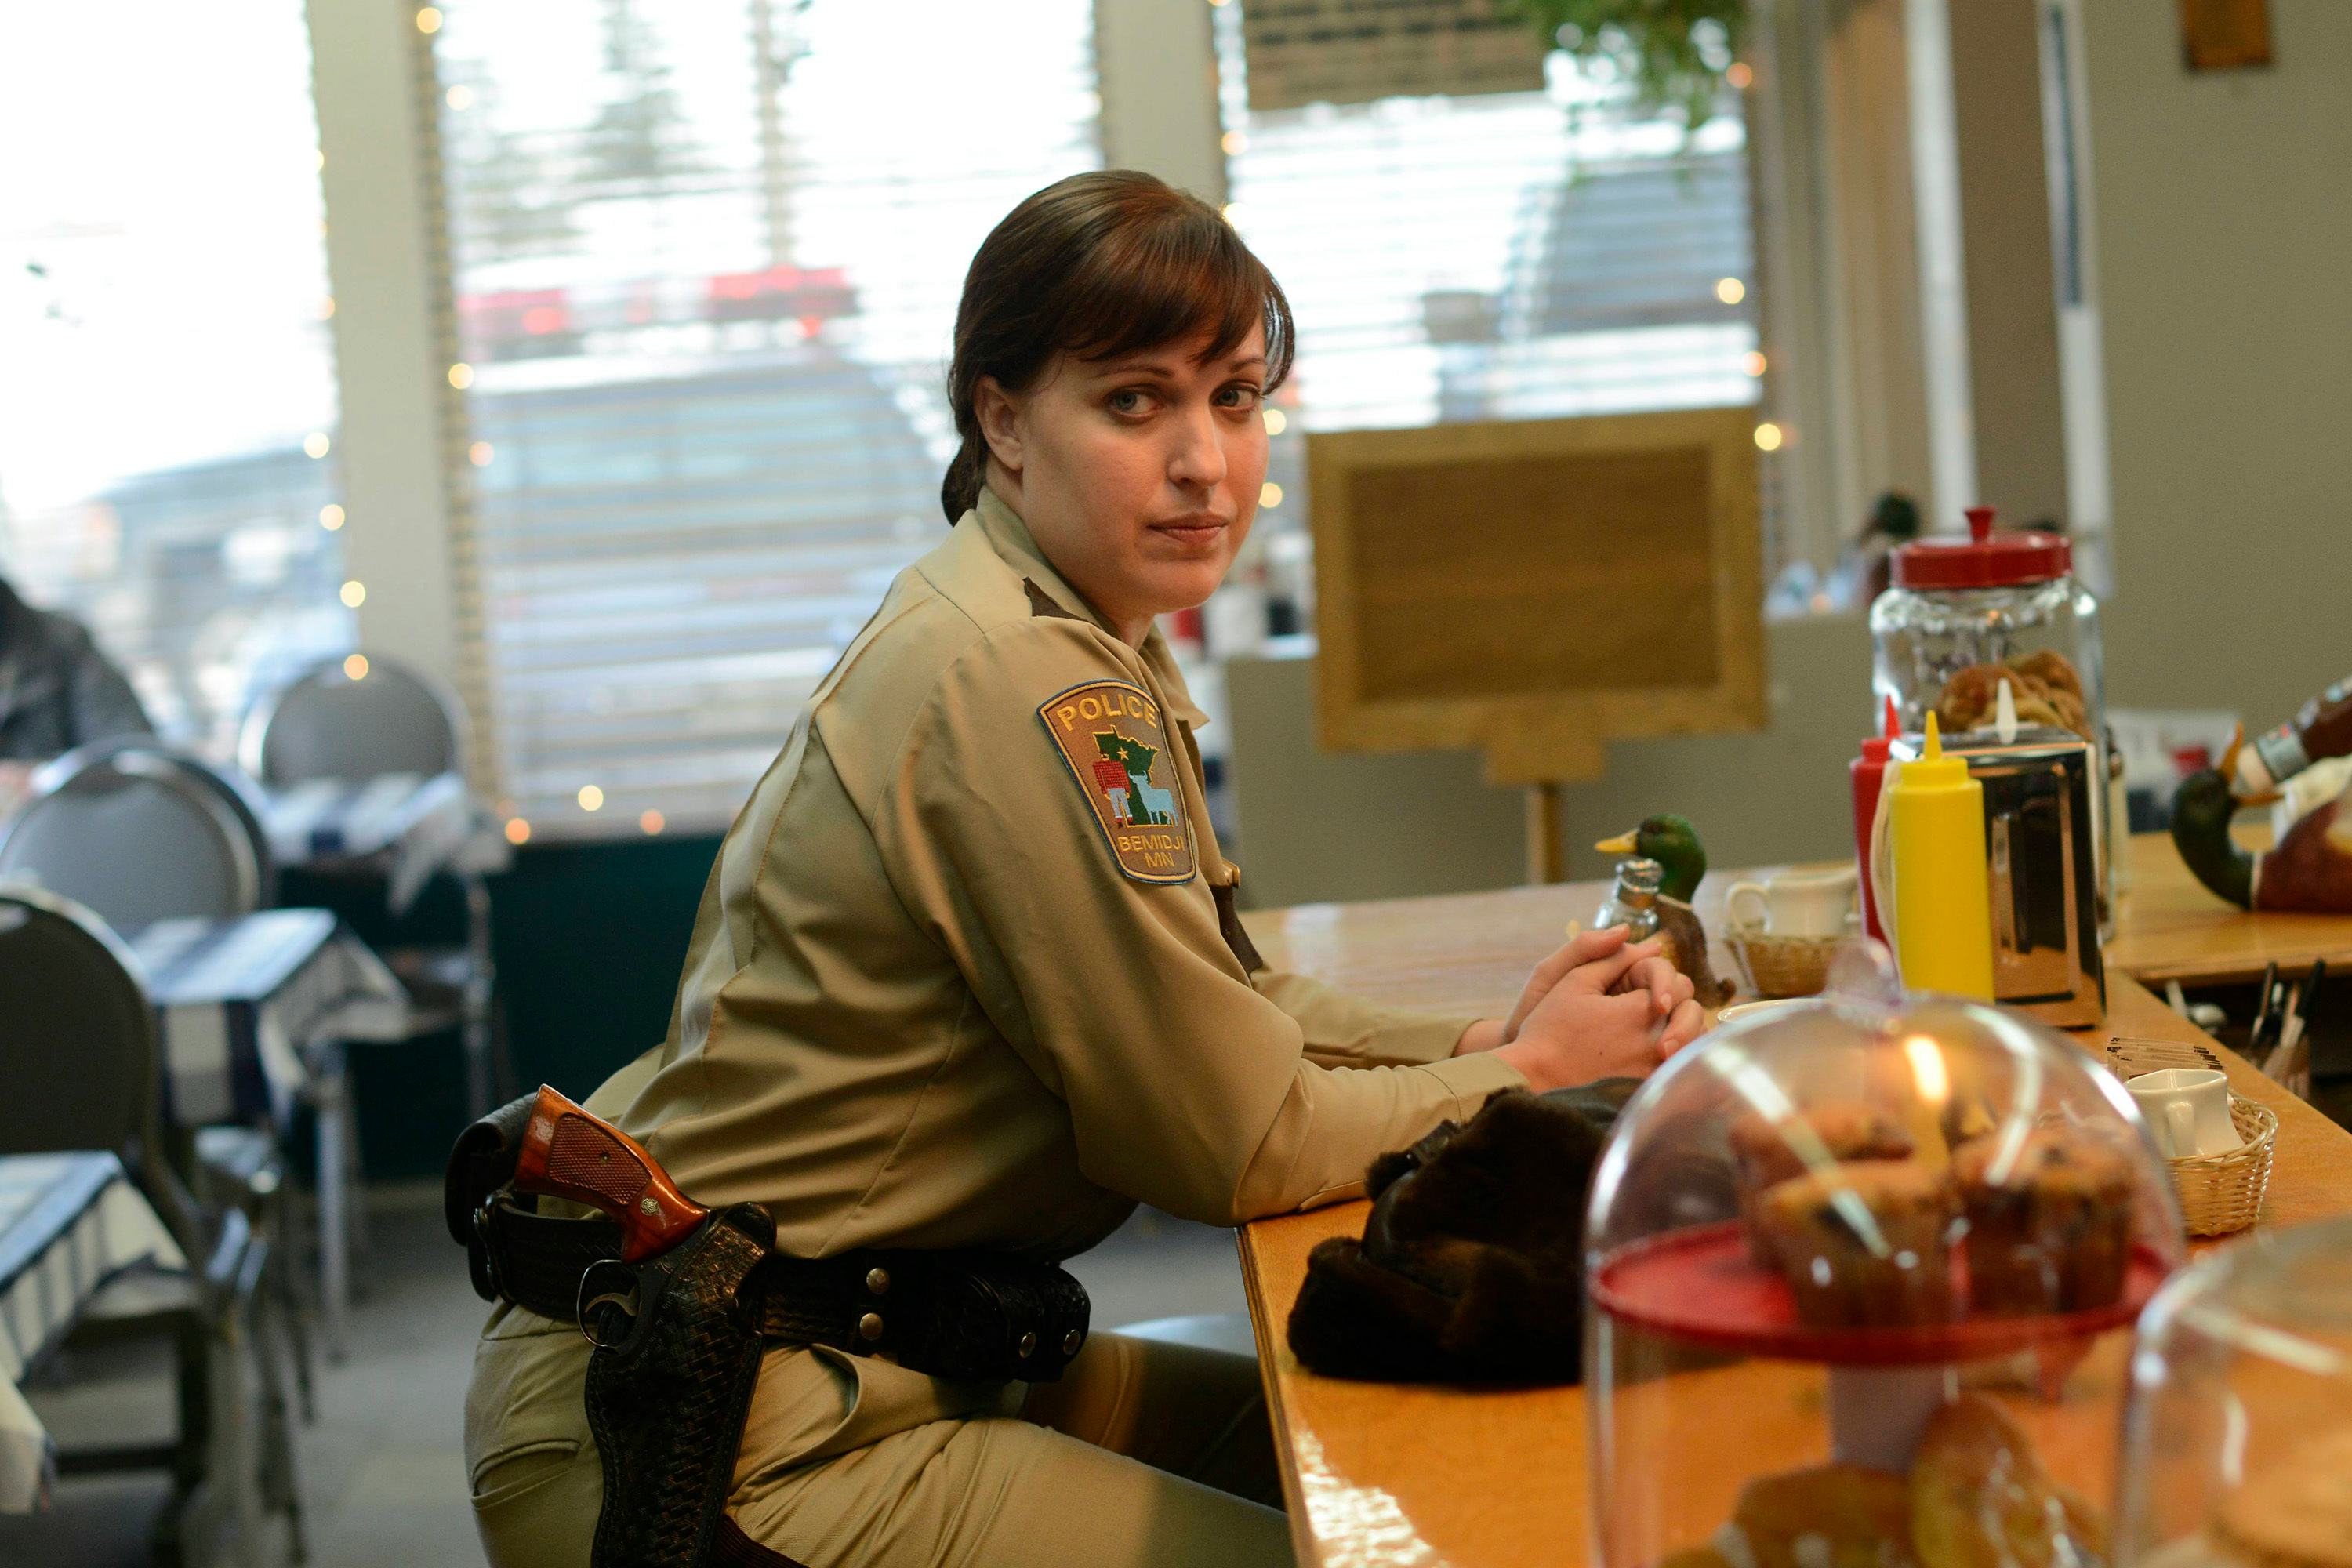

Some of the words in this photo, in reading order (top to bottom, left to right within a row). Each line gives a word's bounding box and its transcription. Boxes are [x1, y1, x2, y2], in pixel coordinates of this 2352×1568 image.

[1057, 694, 1156, 731] POLICE
[1117, 835, 1185, 852] BEMIDJI
[1144, 852, 1174, 867] MN
